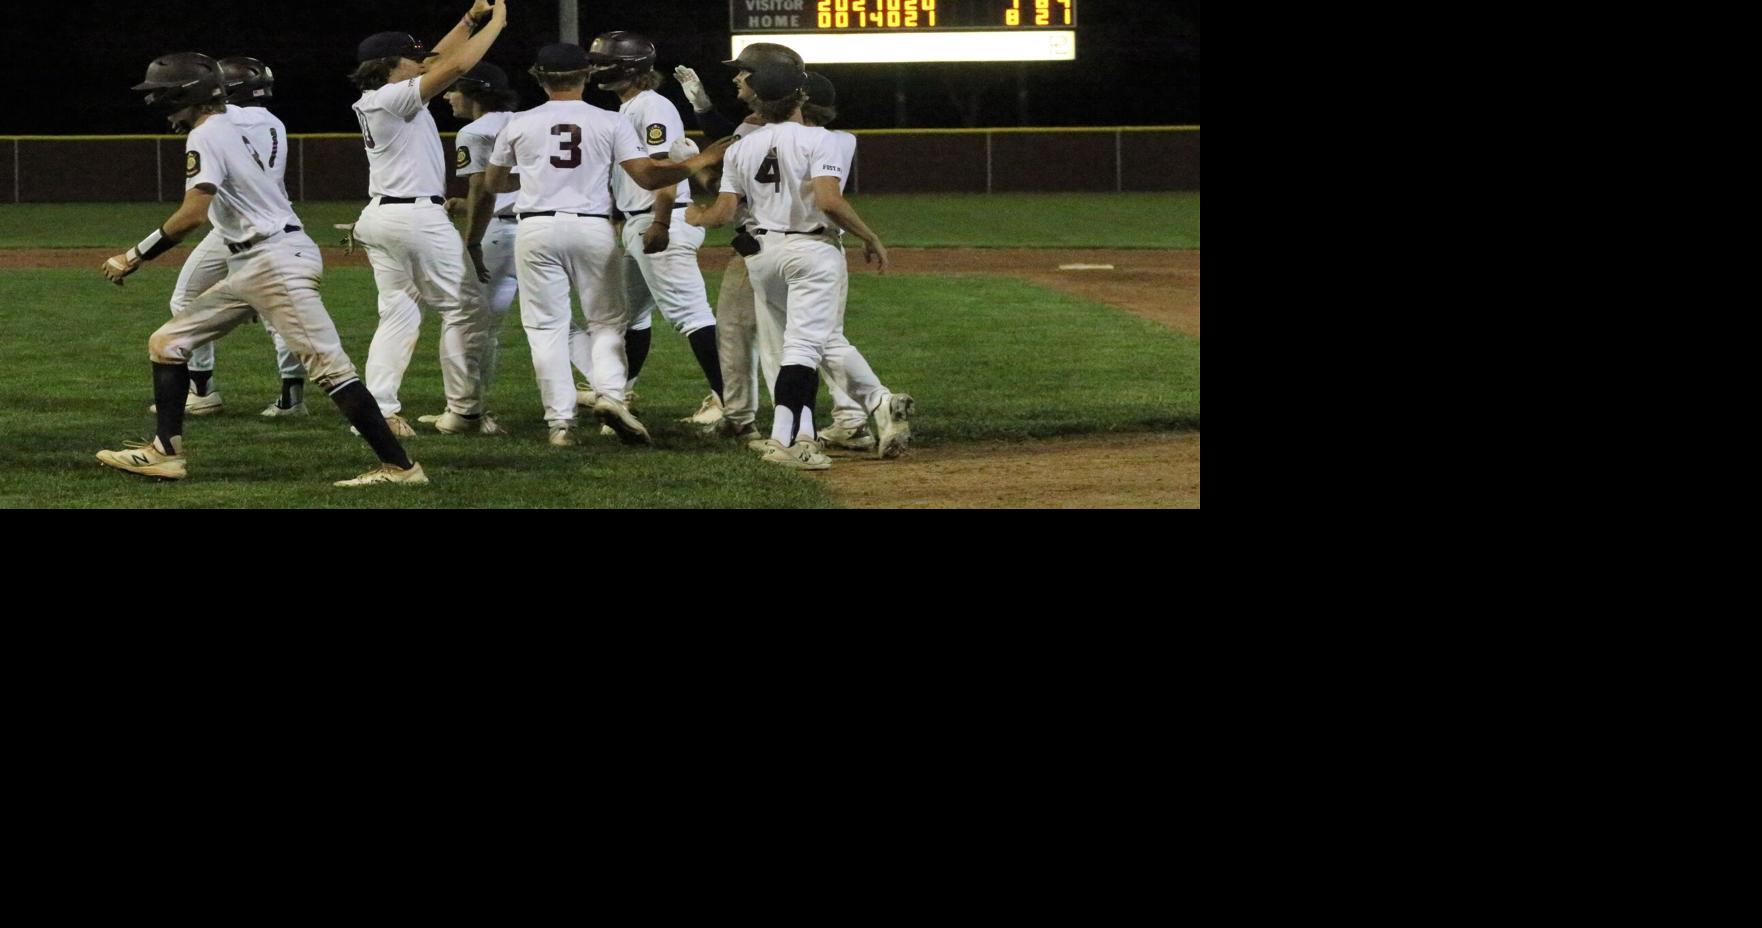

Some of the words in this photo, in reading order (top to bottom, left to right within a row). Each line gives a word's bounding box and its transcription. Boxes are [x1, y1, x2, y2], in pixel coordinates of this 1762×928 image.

[745, 0, 804, 11] VISITOR
[748, 15, 800, 28] HOME
[1005, 9, 1019, 25] 8
[549, 123, 582, 169] 3
[754, 146, 781, 193] 4
